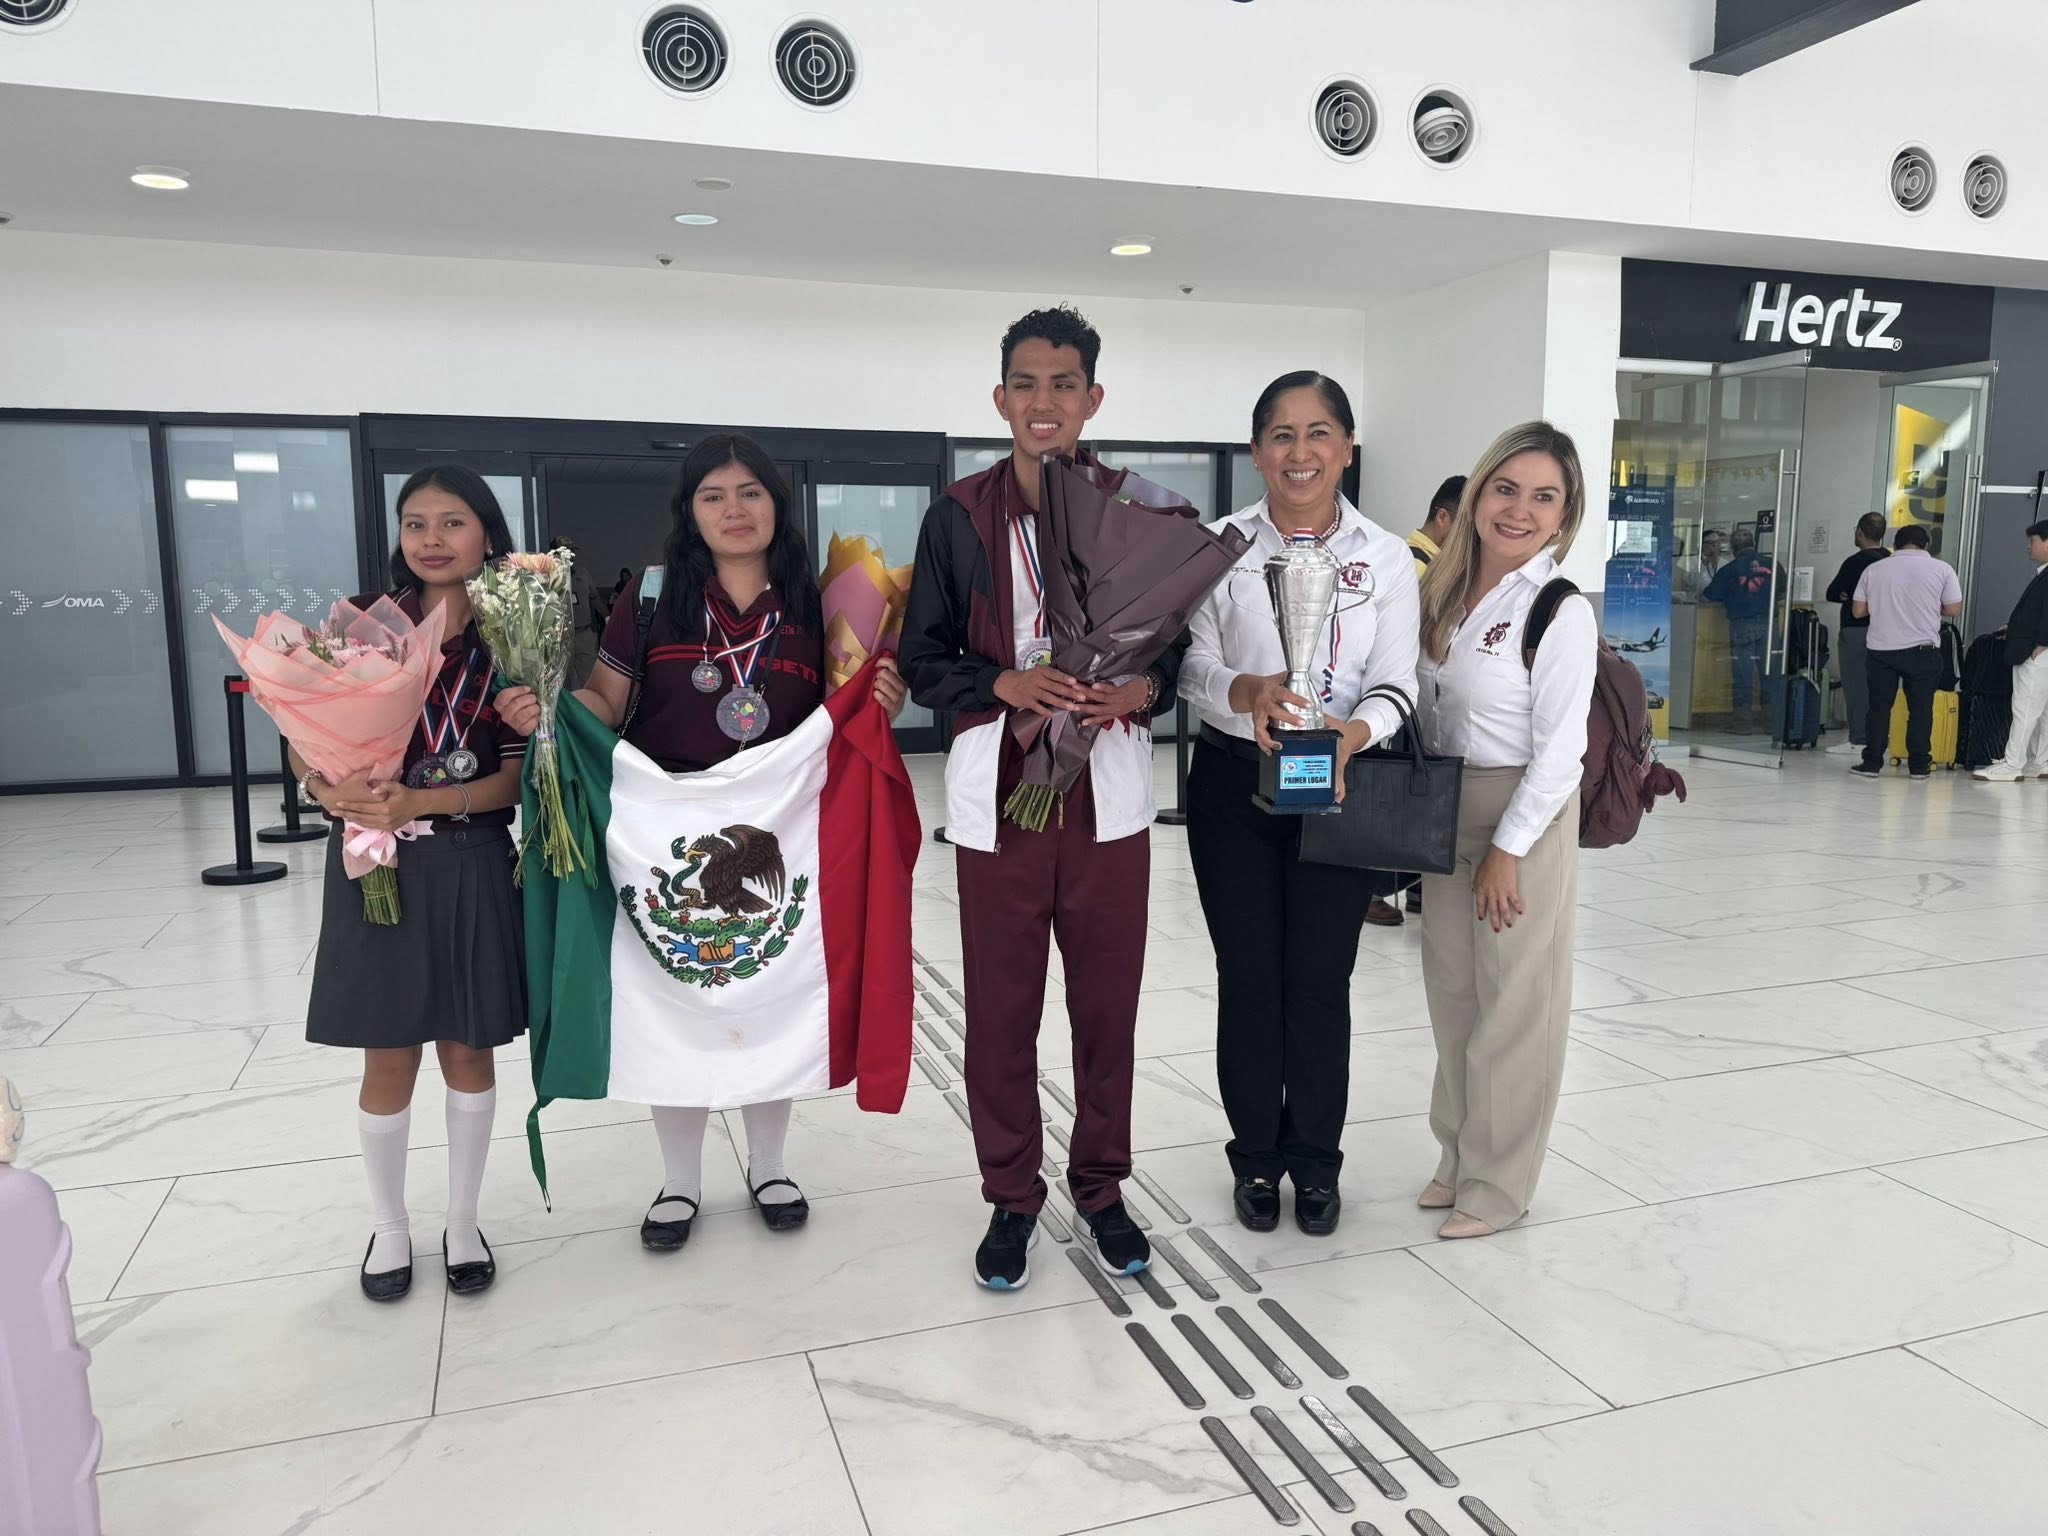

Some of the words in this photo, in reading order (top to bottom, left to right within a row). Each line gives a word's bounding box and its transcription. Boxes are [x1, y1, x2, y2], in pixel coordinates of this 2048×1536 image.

[1745, 281, 1903, 349] Hertz
[64, 597, 105, 608] OMA
[1284, 776, 1307, 785] PRIMER
[1308, 776, 1328, 784] LUGAR
